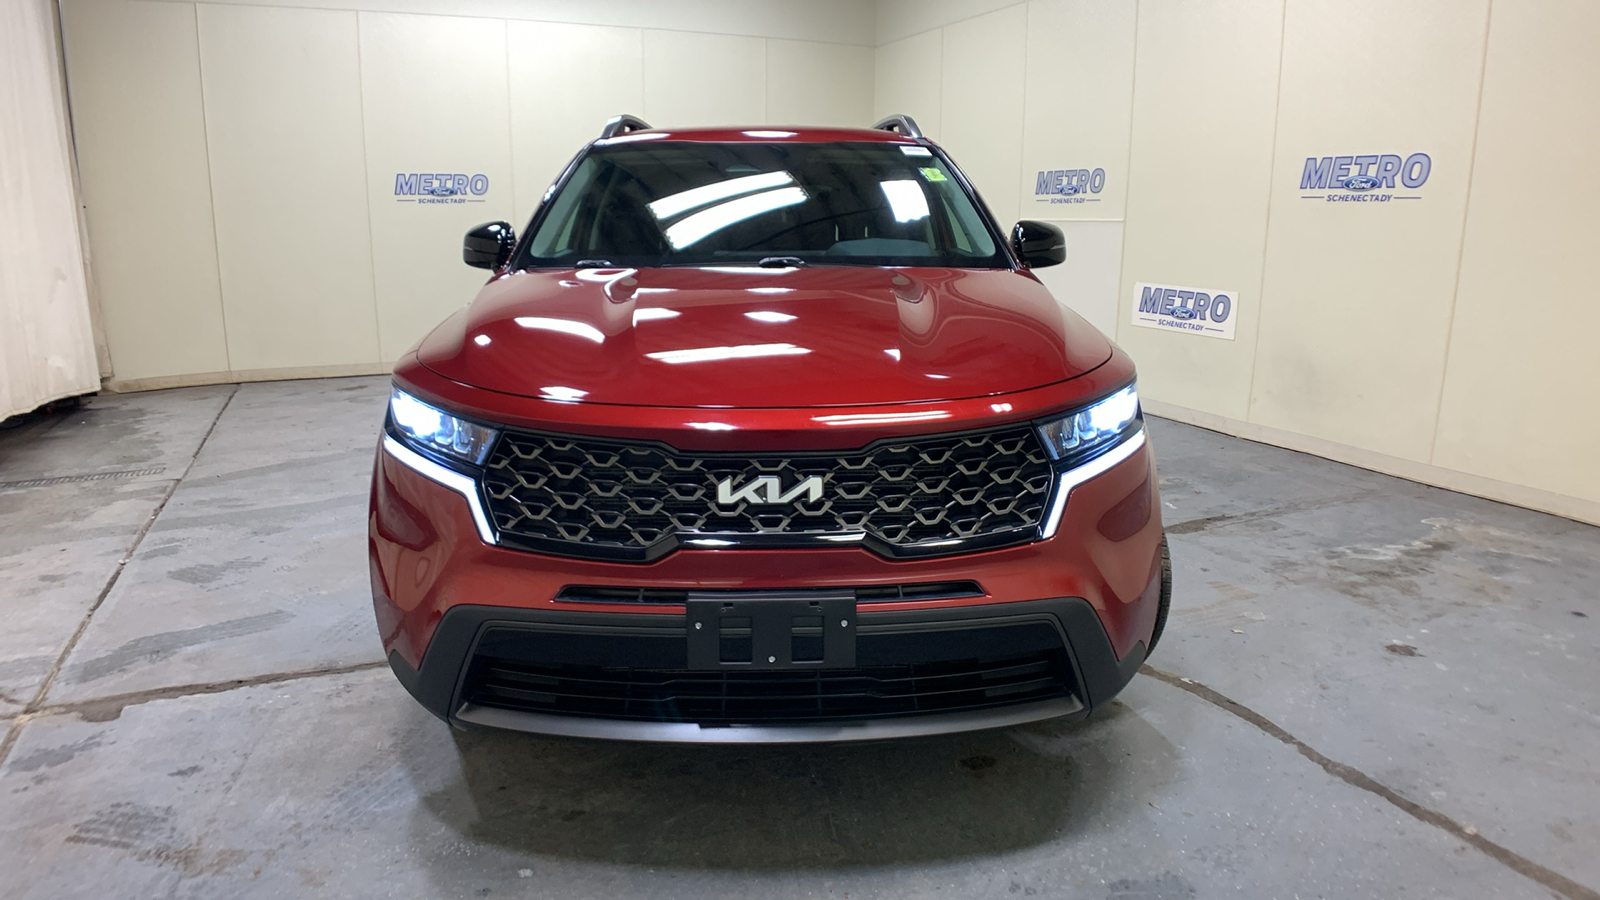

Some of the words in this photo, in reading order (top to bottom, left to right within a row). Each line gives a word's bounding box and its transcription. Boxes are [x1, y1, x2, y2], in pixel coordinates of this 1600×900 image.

[394, 173, 489, 196] METRO
[1035, 167, 1106, 195] METRO
[1299, 152, 1432, 190] METRO
[1326, 194, 1393, 202] SCHENECTADY
[1138, 286, 1232, 324] METRO
[1157, 318, 1205, 331] SCHENECTADY
[717, 475, 824, 504] KIA
